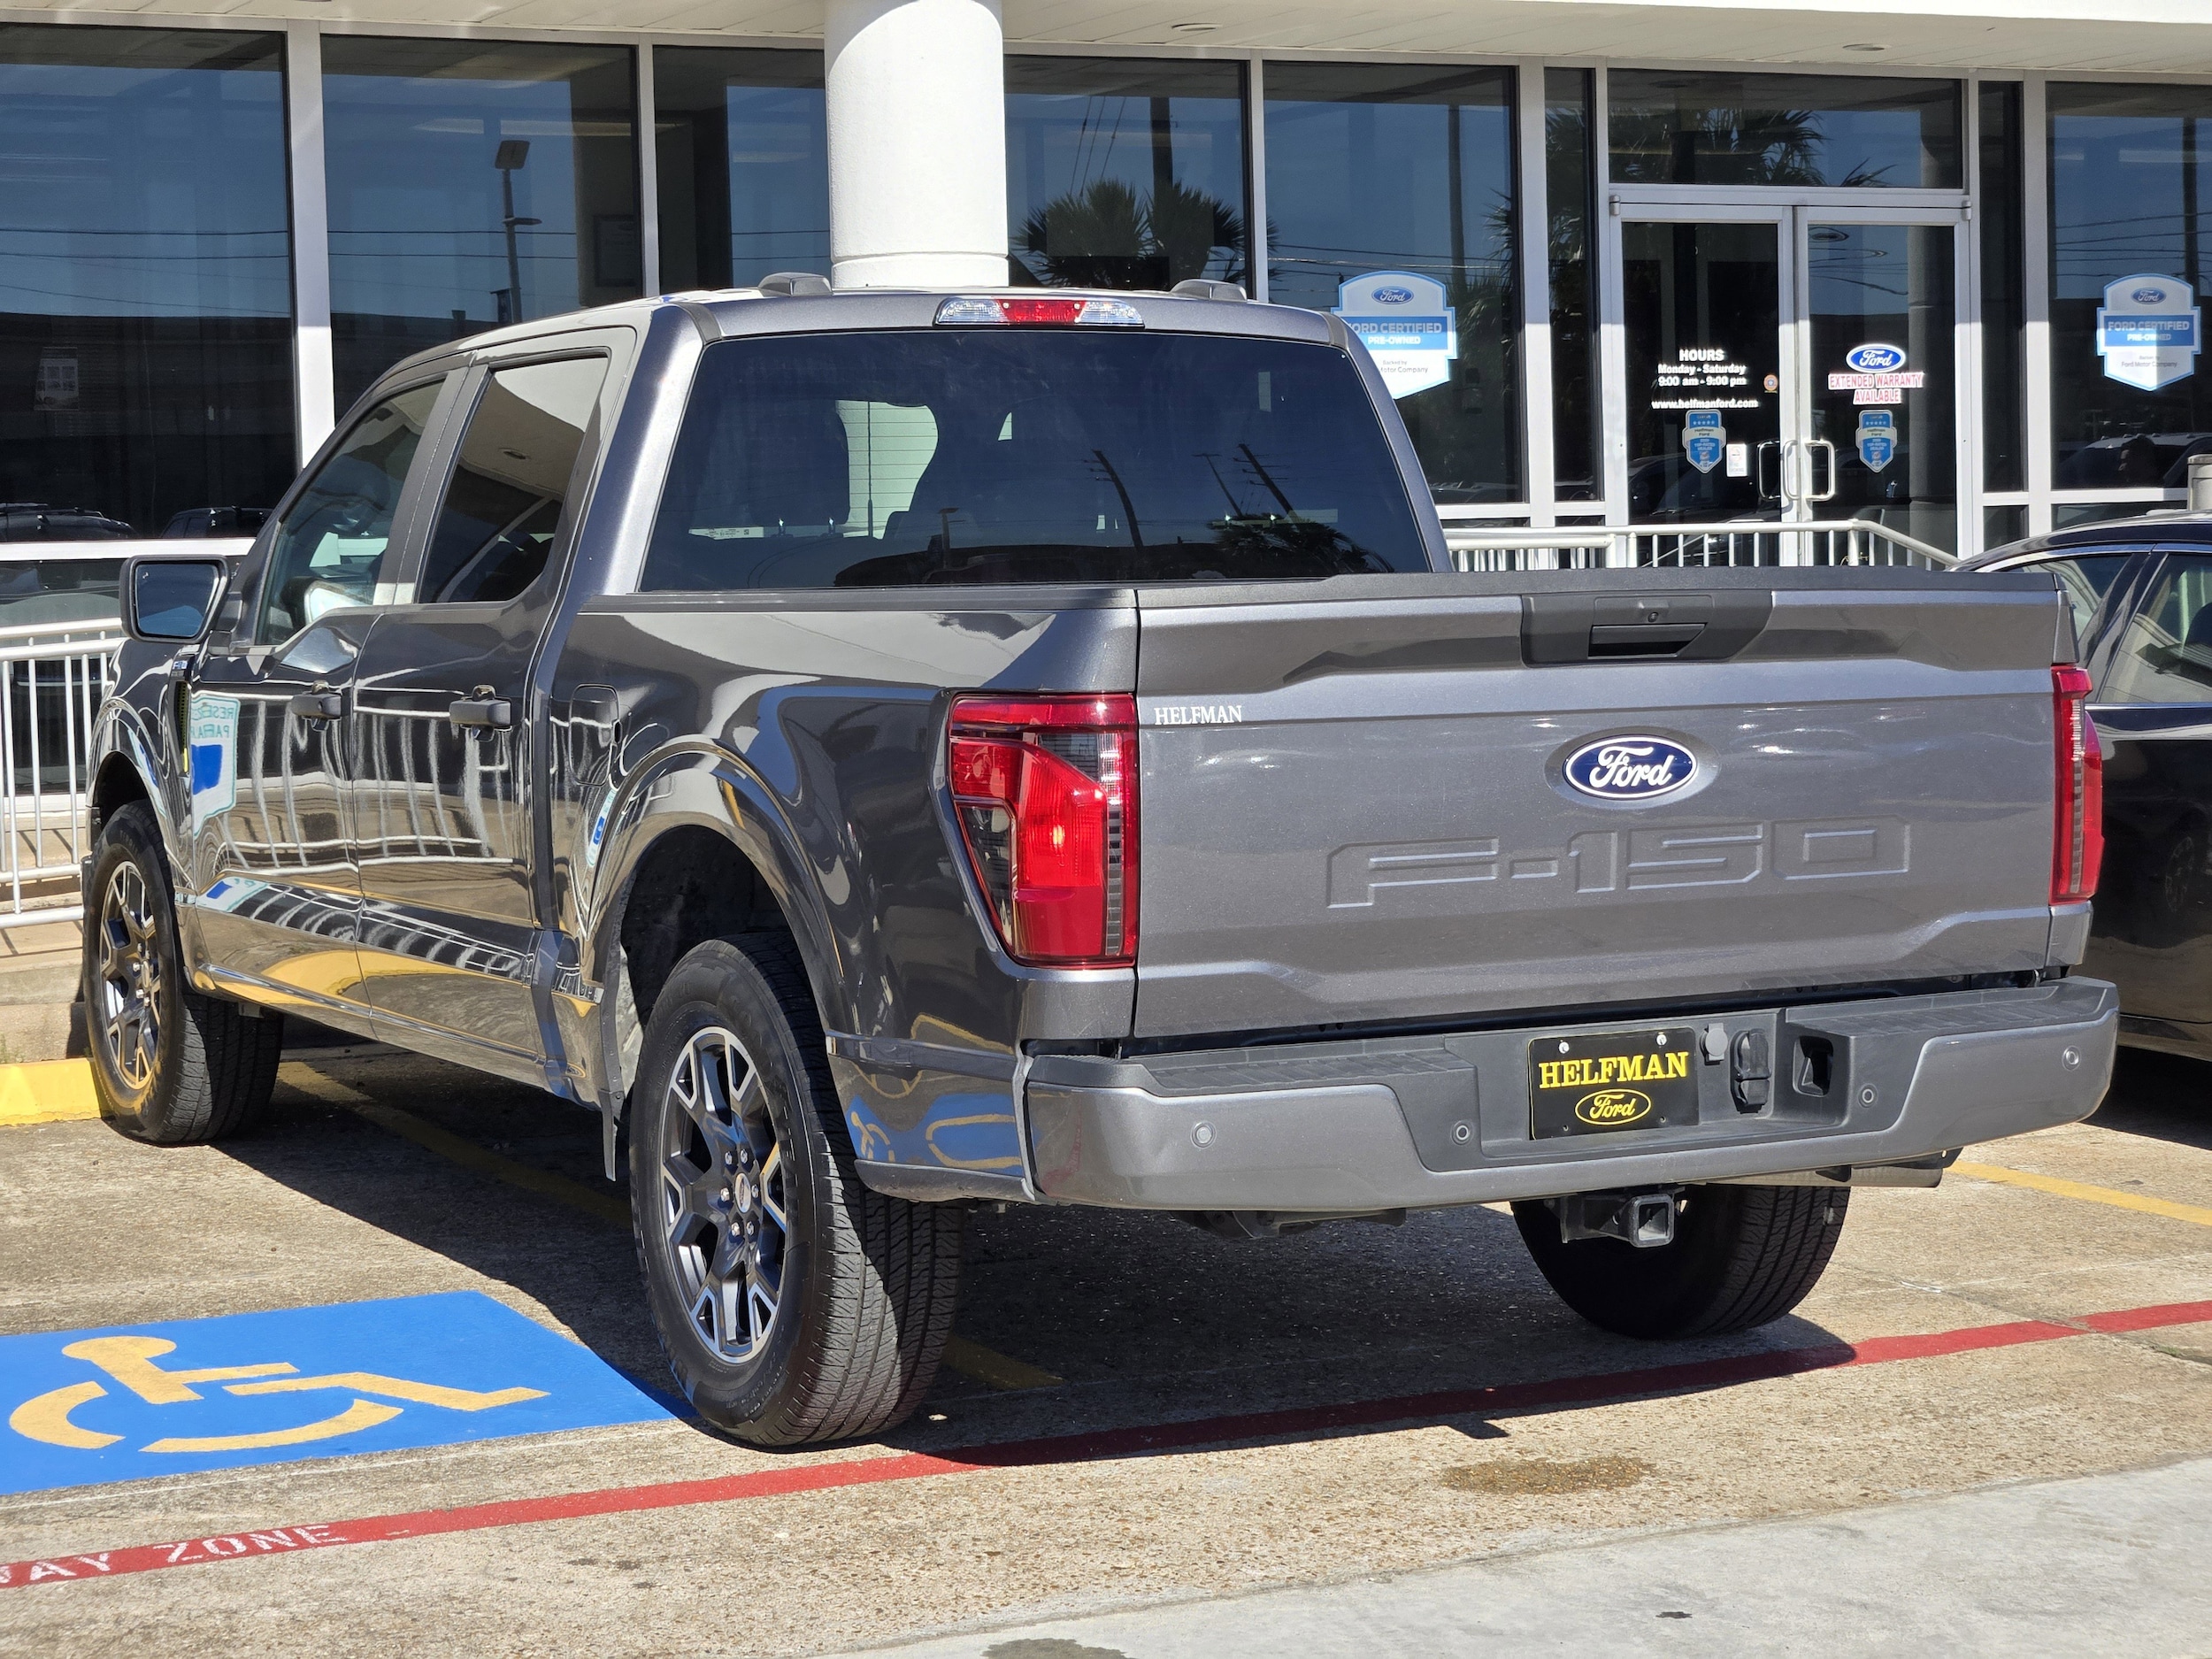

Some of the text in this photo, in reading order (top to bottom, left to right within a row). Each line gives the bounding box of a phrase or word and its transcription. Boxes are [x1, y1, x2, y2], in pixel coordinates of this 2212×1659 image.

[1379, 289, 1405, 303] Ford
[2138, 290, 2159, 302] Ford
[1348, 322, 1442, 334] ORD CERTIFIED
[2108, 320, 2190, 331] FORD CERTIFIED
[1368, 336, 1421, 345] PRE-OWNED
[1679, 349, 1724, 361] HOURS
[1859, 349, 1893, 366] Ford
[1398, 365, 1428, 374] Company
[1658, 364, 1695, 375] Monday
[1702, 364, 1747, 375] Saturday
[1658, 376, 1679, 387] 9:00
[1730, 377, 1747, 387] pm
[1830, 374, 1922, 388] EXTENDED WARRANTY
[1855, 389, 1900, 402] AVAILABLE
[1651, 398, 1759, 409] www.helfmanford.com
[1154, 705, 1242, 725] HELFMAN
[1589, 745, 1674, 787] Ford
[1327, 814, 1910, 909] F-150
[1538, 1051, 1689, 1089] HELFMAN
[1590, 1094, 1637, 1119] Ford
[152, 1525, 348, 1563] ZONE
